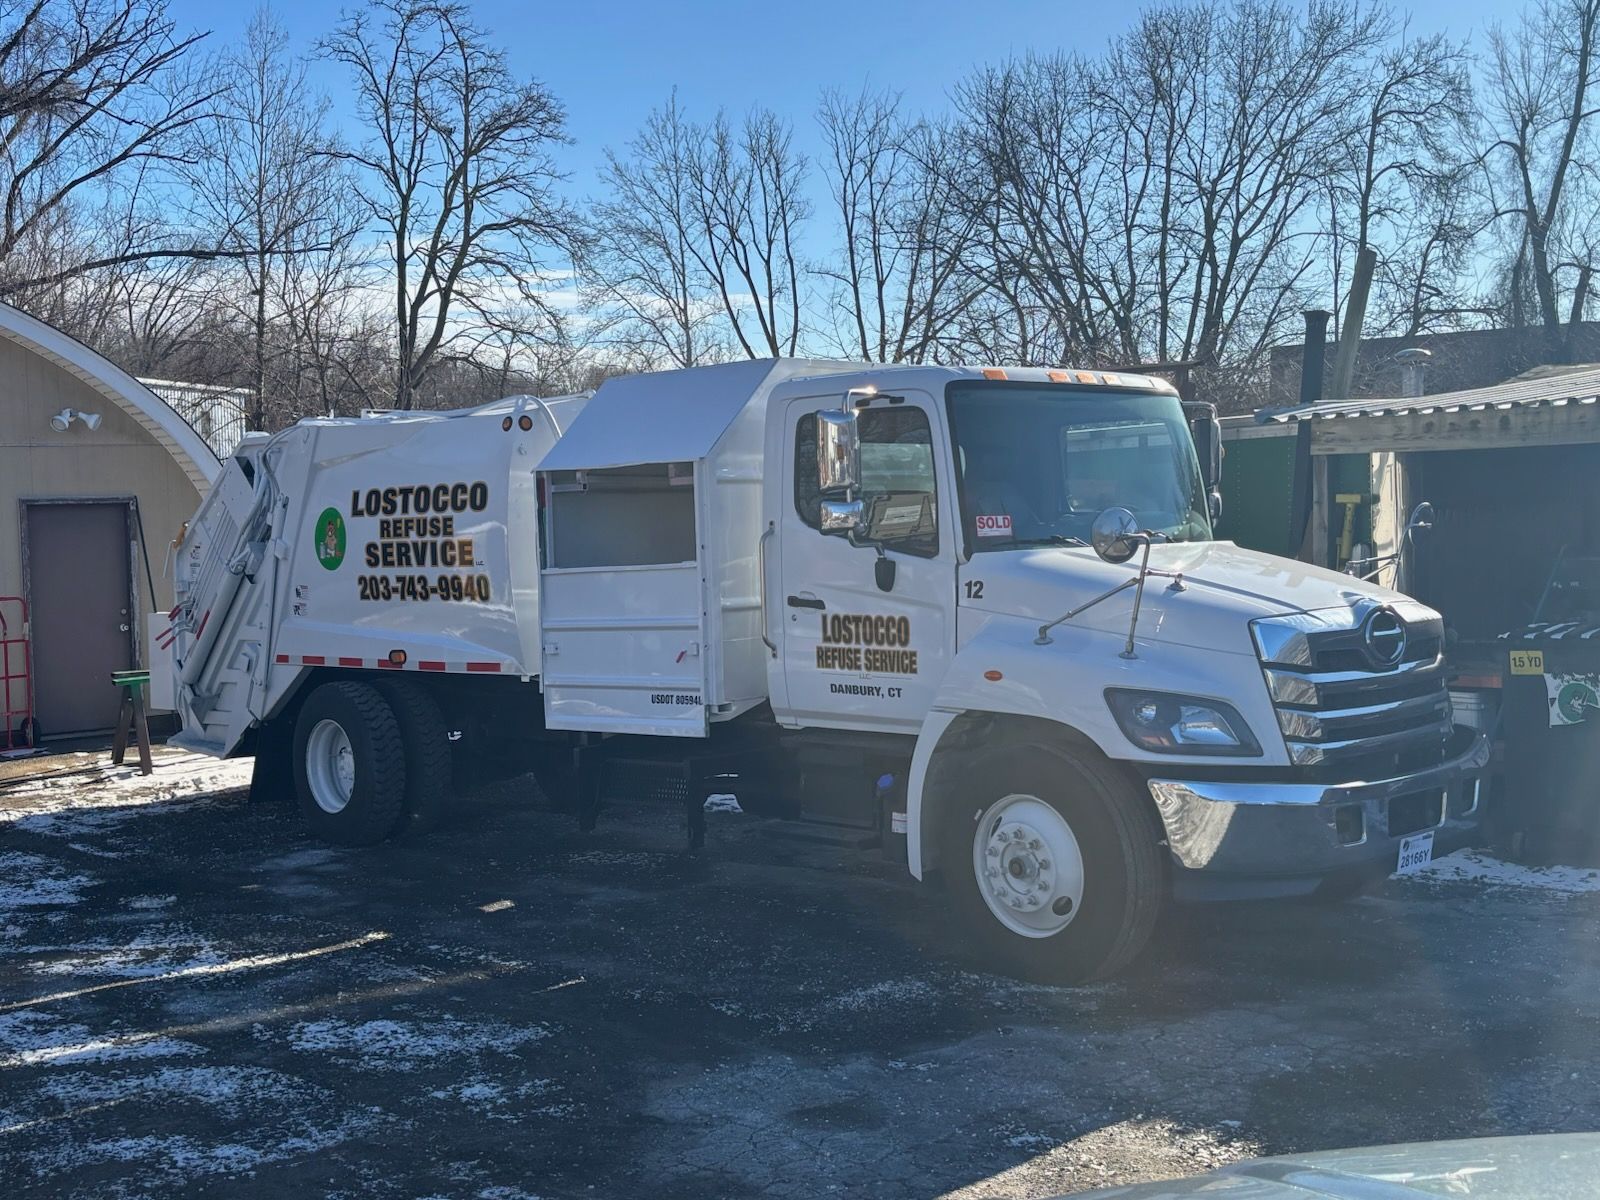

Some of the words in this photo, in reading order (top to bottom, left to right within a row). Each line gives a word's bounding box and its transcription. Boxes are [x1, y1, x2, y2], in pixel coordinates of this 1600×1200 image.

[351, 480, 488, 517] LOSTOCCO
[380, 515, 454, 539] REFUSE
[978, 516, 1011, 529] SOLD
[365, 538, 474, 568] SERVICE
[357, 573, 490, 602] 203-743-9940
[964, 580, 984, 599] 12
[821, 613, 910, 647] LOSTOCCO
[816, 646, 862, 671] REFUSE
[863, 649, 918, 674] SERVICE
[1527, 656, 1542, 668] YD
[651, 694, 674, 705] USDOT
[830, 683, 884, 699] DANBURY,
[887, 687, 902, 698] CT
[1400, 848, 1430, 869] 28166Y
